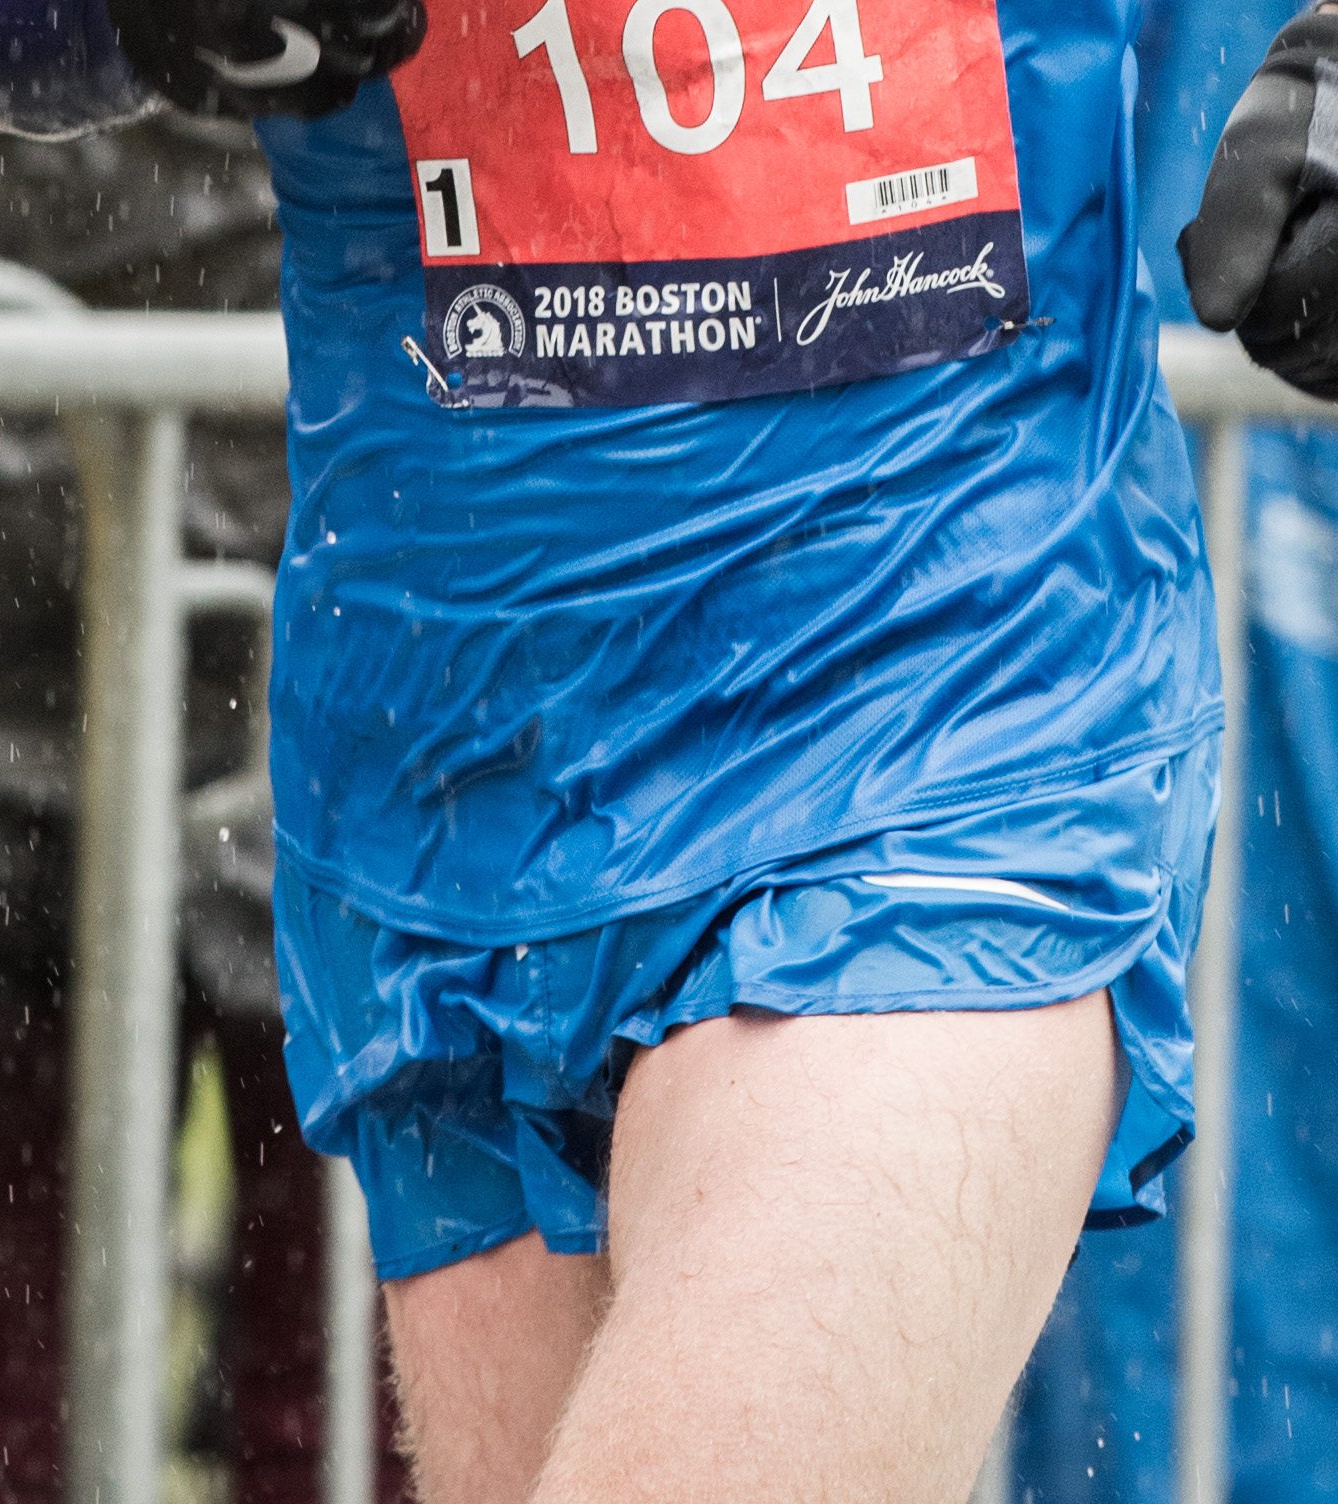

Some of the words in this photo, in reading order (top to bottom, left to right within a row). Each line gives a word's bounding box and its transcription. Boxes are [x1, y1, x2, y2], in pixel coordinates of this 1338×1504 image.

[425, 168, 462, 247] 1
[534, 285, 606, 319] 2018
[615, 281, 752, 317] BOSTON
[535, 316, 757, 358] MARATHON
